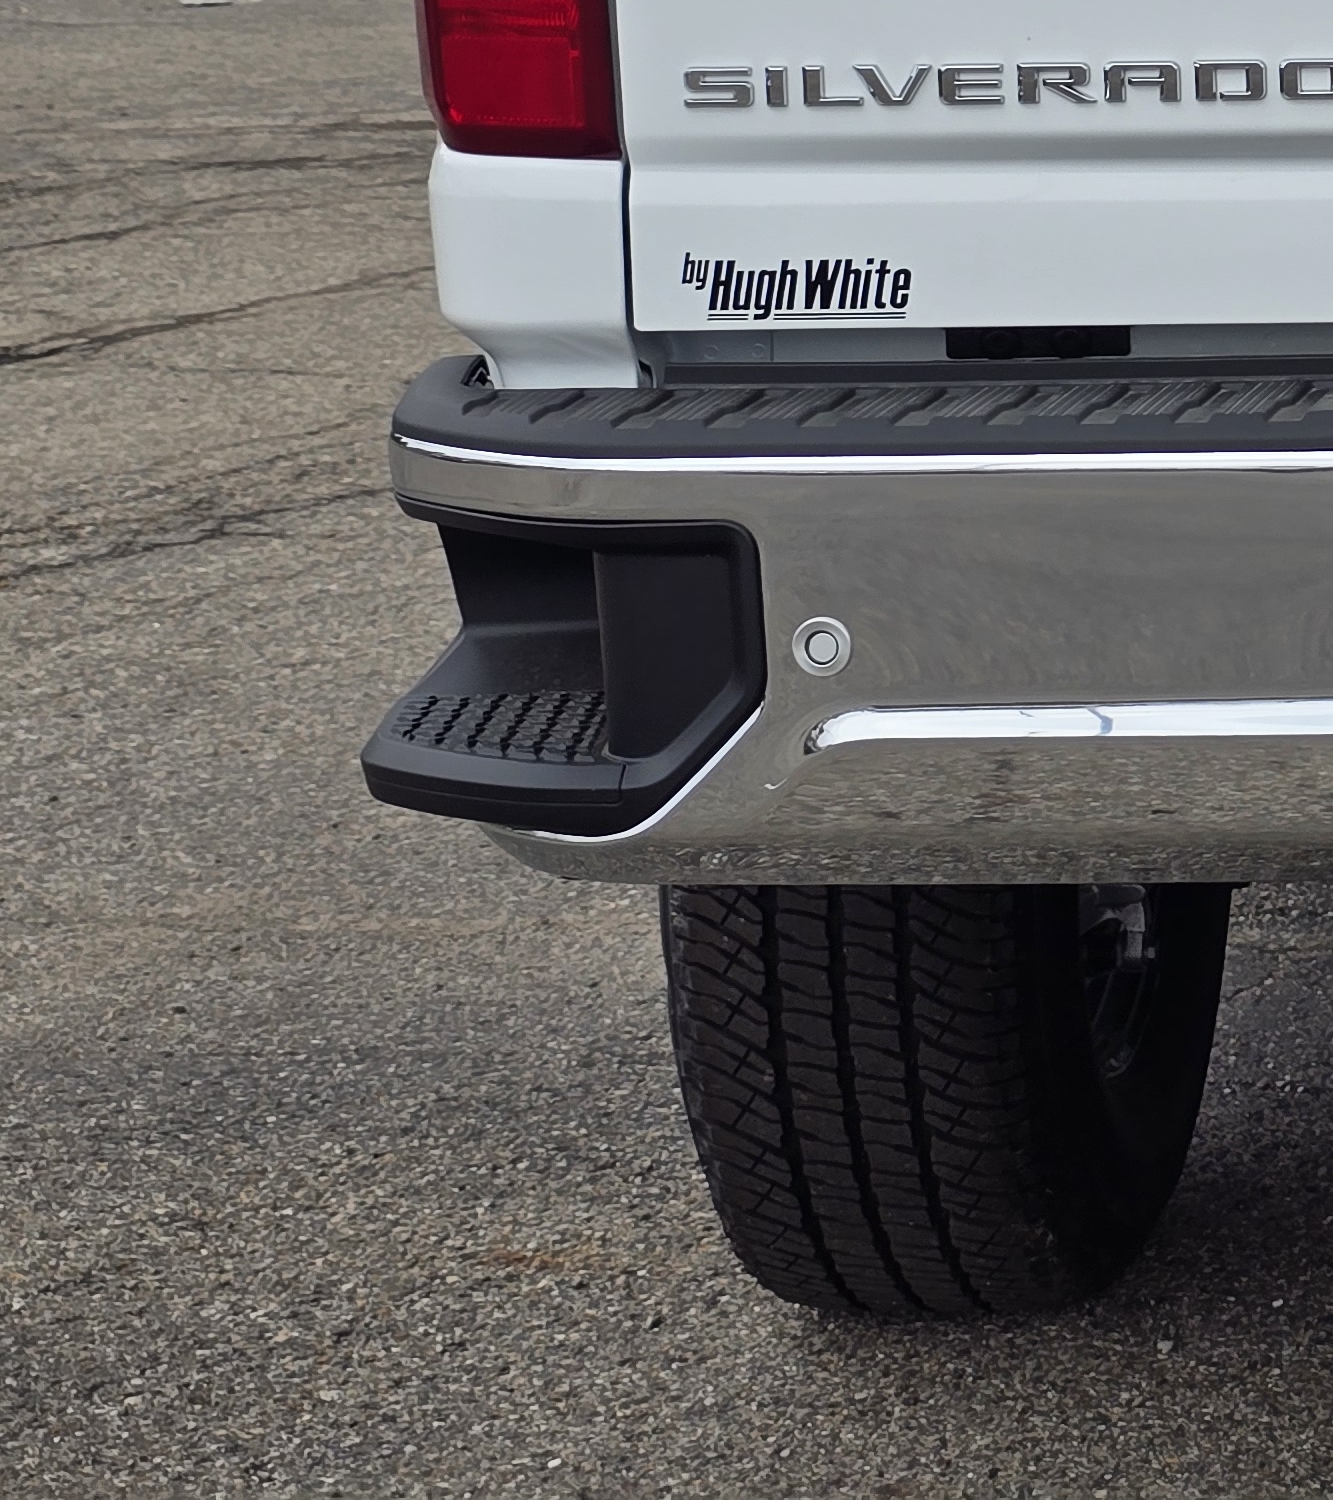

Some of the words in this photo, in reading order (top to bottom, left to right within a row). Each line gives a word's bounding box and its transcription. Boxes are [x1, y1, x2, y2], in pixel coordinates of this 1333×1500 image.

[681, 252, 709, 291] by
[708, 259, 799, 320] Hugh
[803, 257, 912, 311] White
